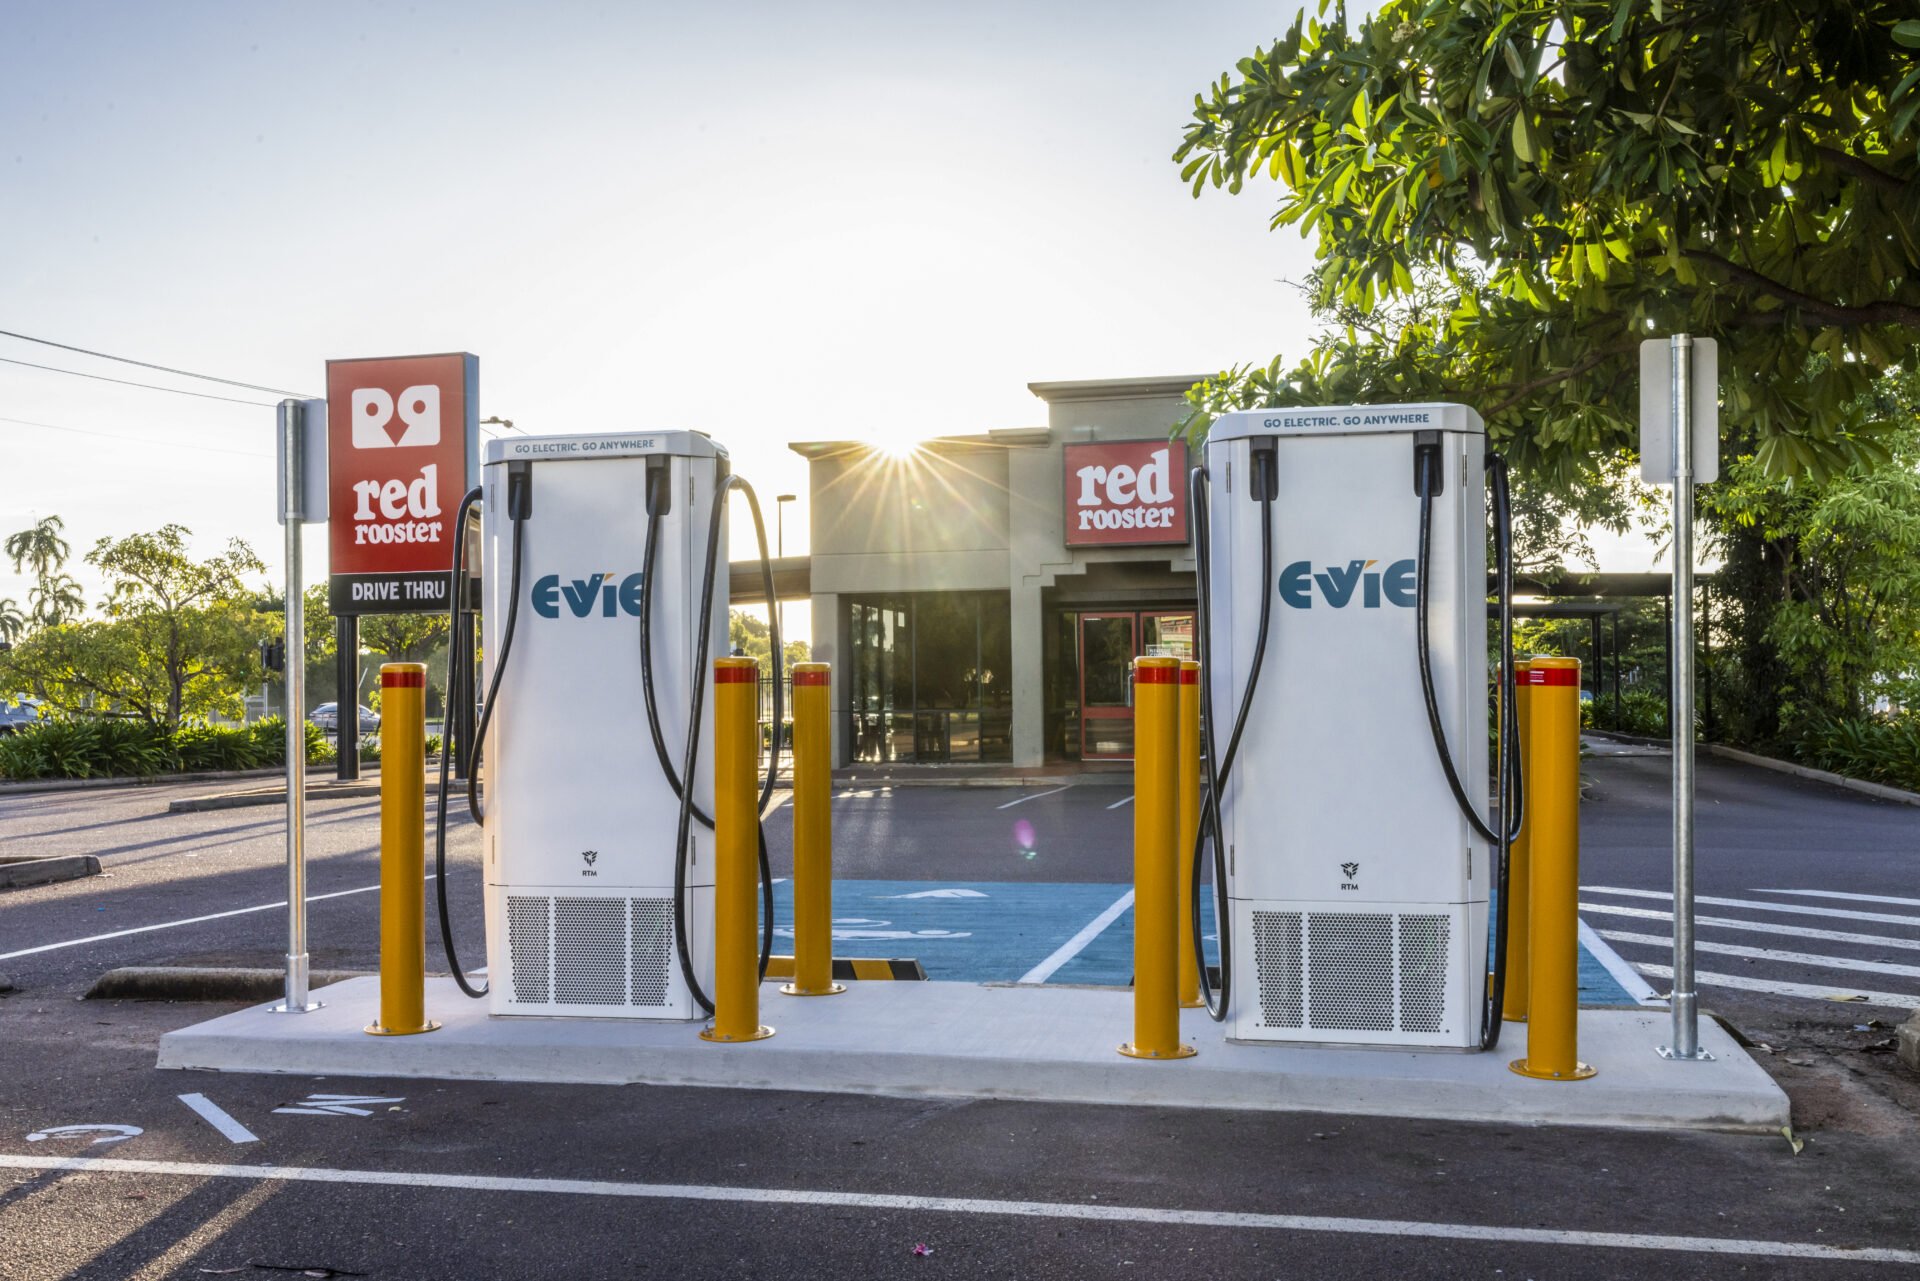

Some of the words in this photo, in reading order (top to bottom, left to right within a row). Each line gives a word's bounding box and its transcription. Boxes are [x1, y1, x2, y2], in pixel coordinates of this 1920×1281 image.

[1264, 418, 1281, 428] GO
[1284, 416, 1340, 428] ELECTRIC.
[1343, 415, 1361, 427] GO
[1363, 413, 1429, 426] ANYWHERE
[515, 444, 530, 454] GO
[532, 442, 580, 453] ELECTRIC.
[582, 441, 597, 451] GO
[599, 439, 655, 450] ANYWHERE
[1076, 448, 1174, 506] red
[353, 463, 442, 521] red
[1078, 505, 1175, 530] rooster
[355, 520, 443, 545] rooster
[352, 581, 399, 601] DRIVE
[403, 580, 445, 600] THRU
[1341, 883, 1359, 891] RTM
